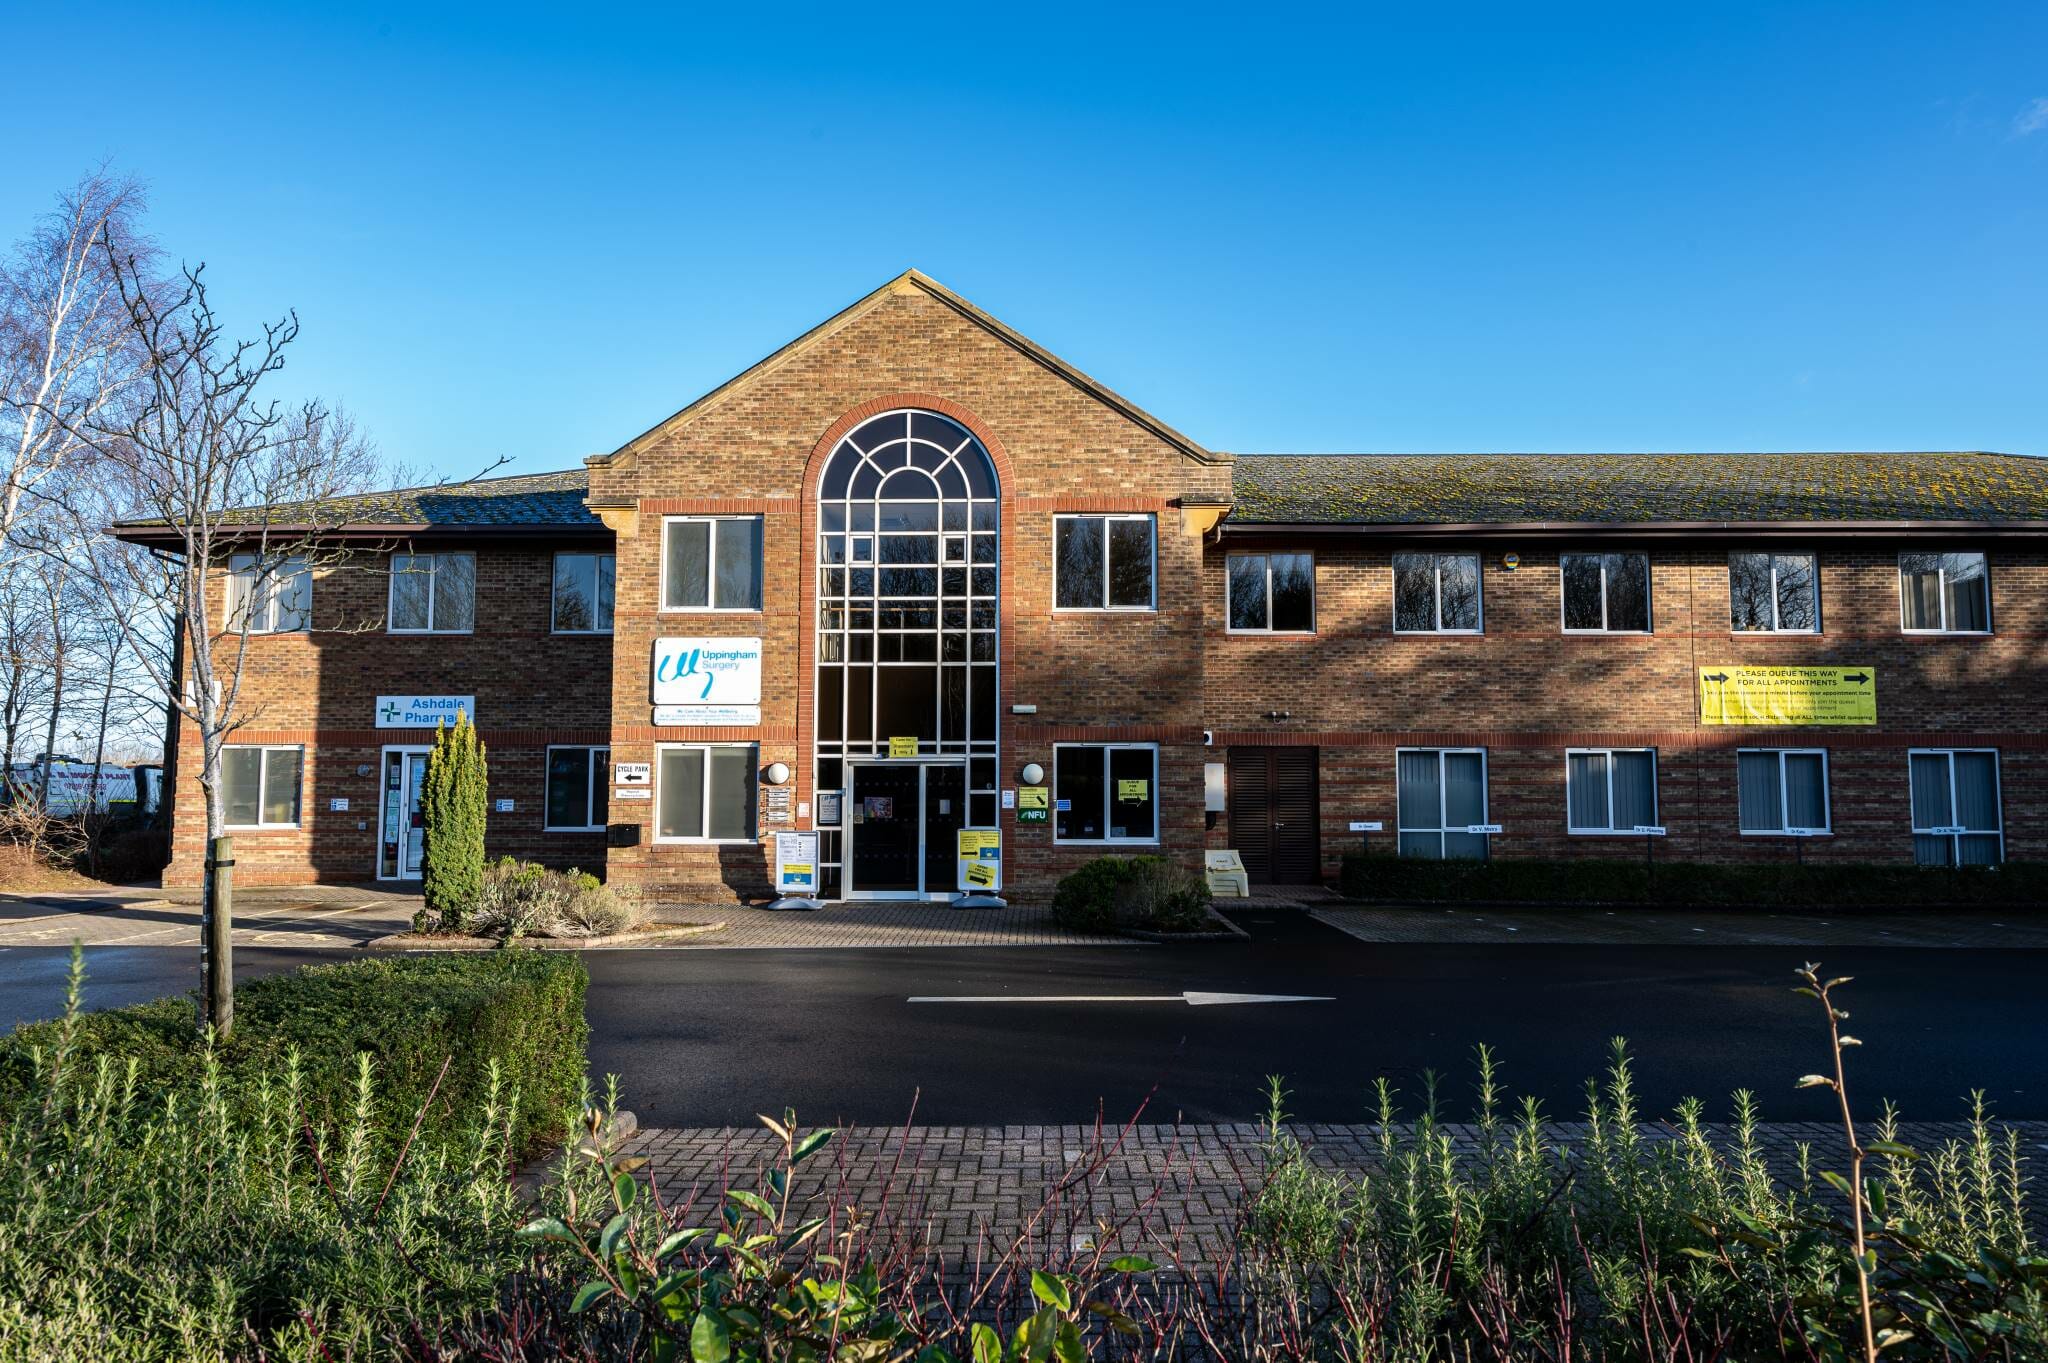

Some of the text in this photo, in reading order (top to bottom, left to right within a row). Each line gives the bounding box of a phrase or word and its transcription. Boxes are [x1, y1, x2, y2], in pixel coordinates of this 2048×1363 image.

[702, 650, 757, 661] Uppingham
[702, 660, 739, 671] Surgery
[412, 698, 465, 709] Ashdale
[405, 713, 470, 722] Pharma
[617, 765, 649, 773] CYCLE PARK
[1028, 810, 1046, 819] NFU
